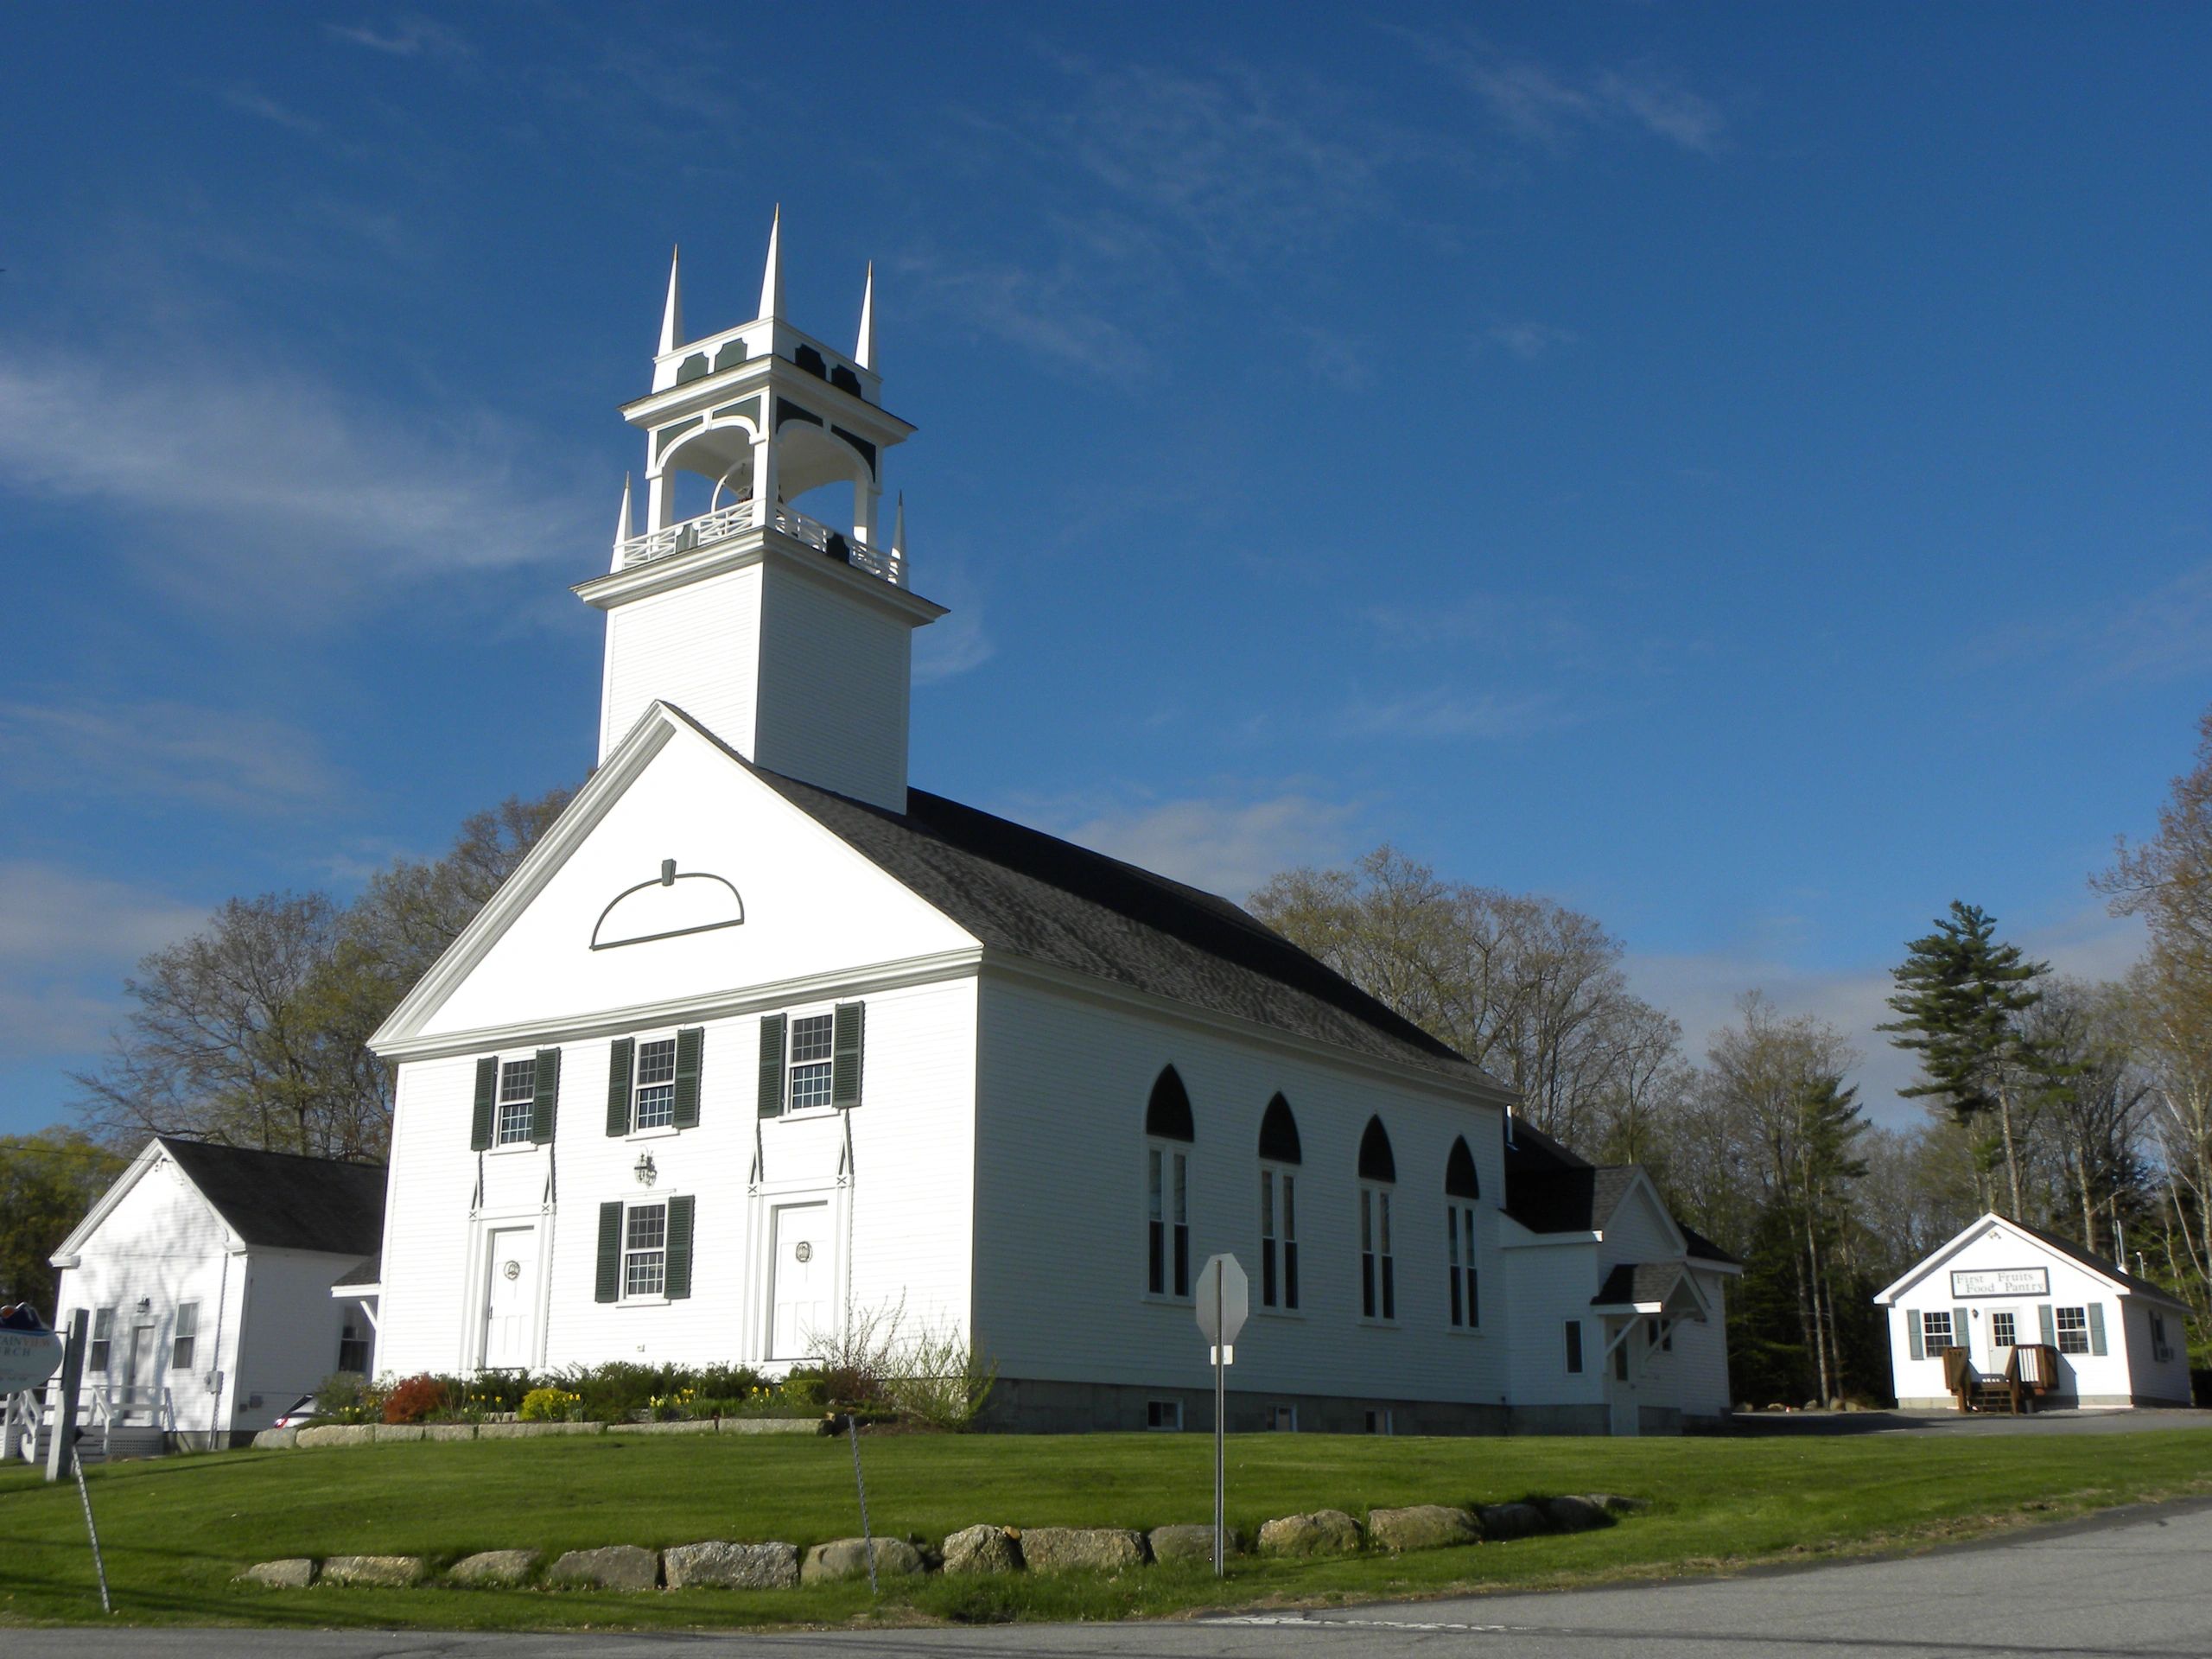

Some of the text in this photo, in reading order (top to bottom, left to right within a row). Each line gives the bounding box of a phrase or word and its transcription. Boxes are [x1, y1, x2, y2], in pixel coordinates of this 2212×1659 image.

[1956, 1272, 2033, 1284] First Fruits
[1966, 1282, 2044, 1294] Food Pantry
